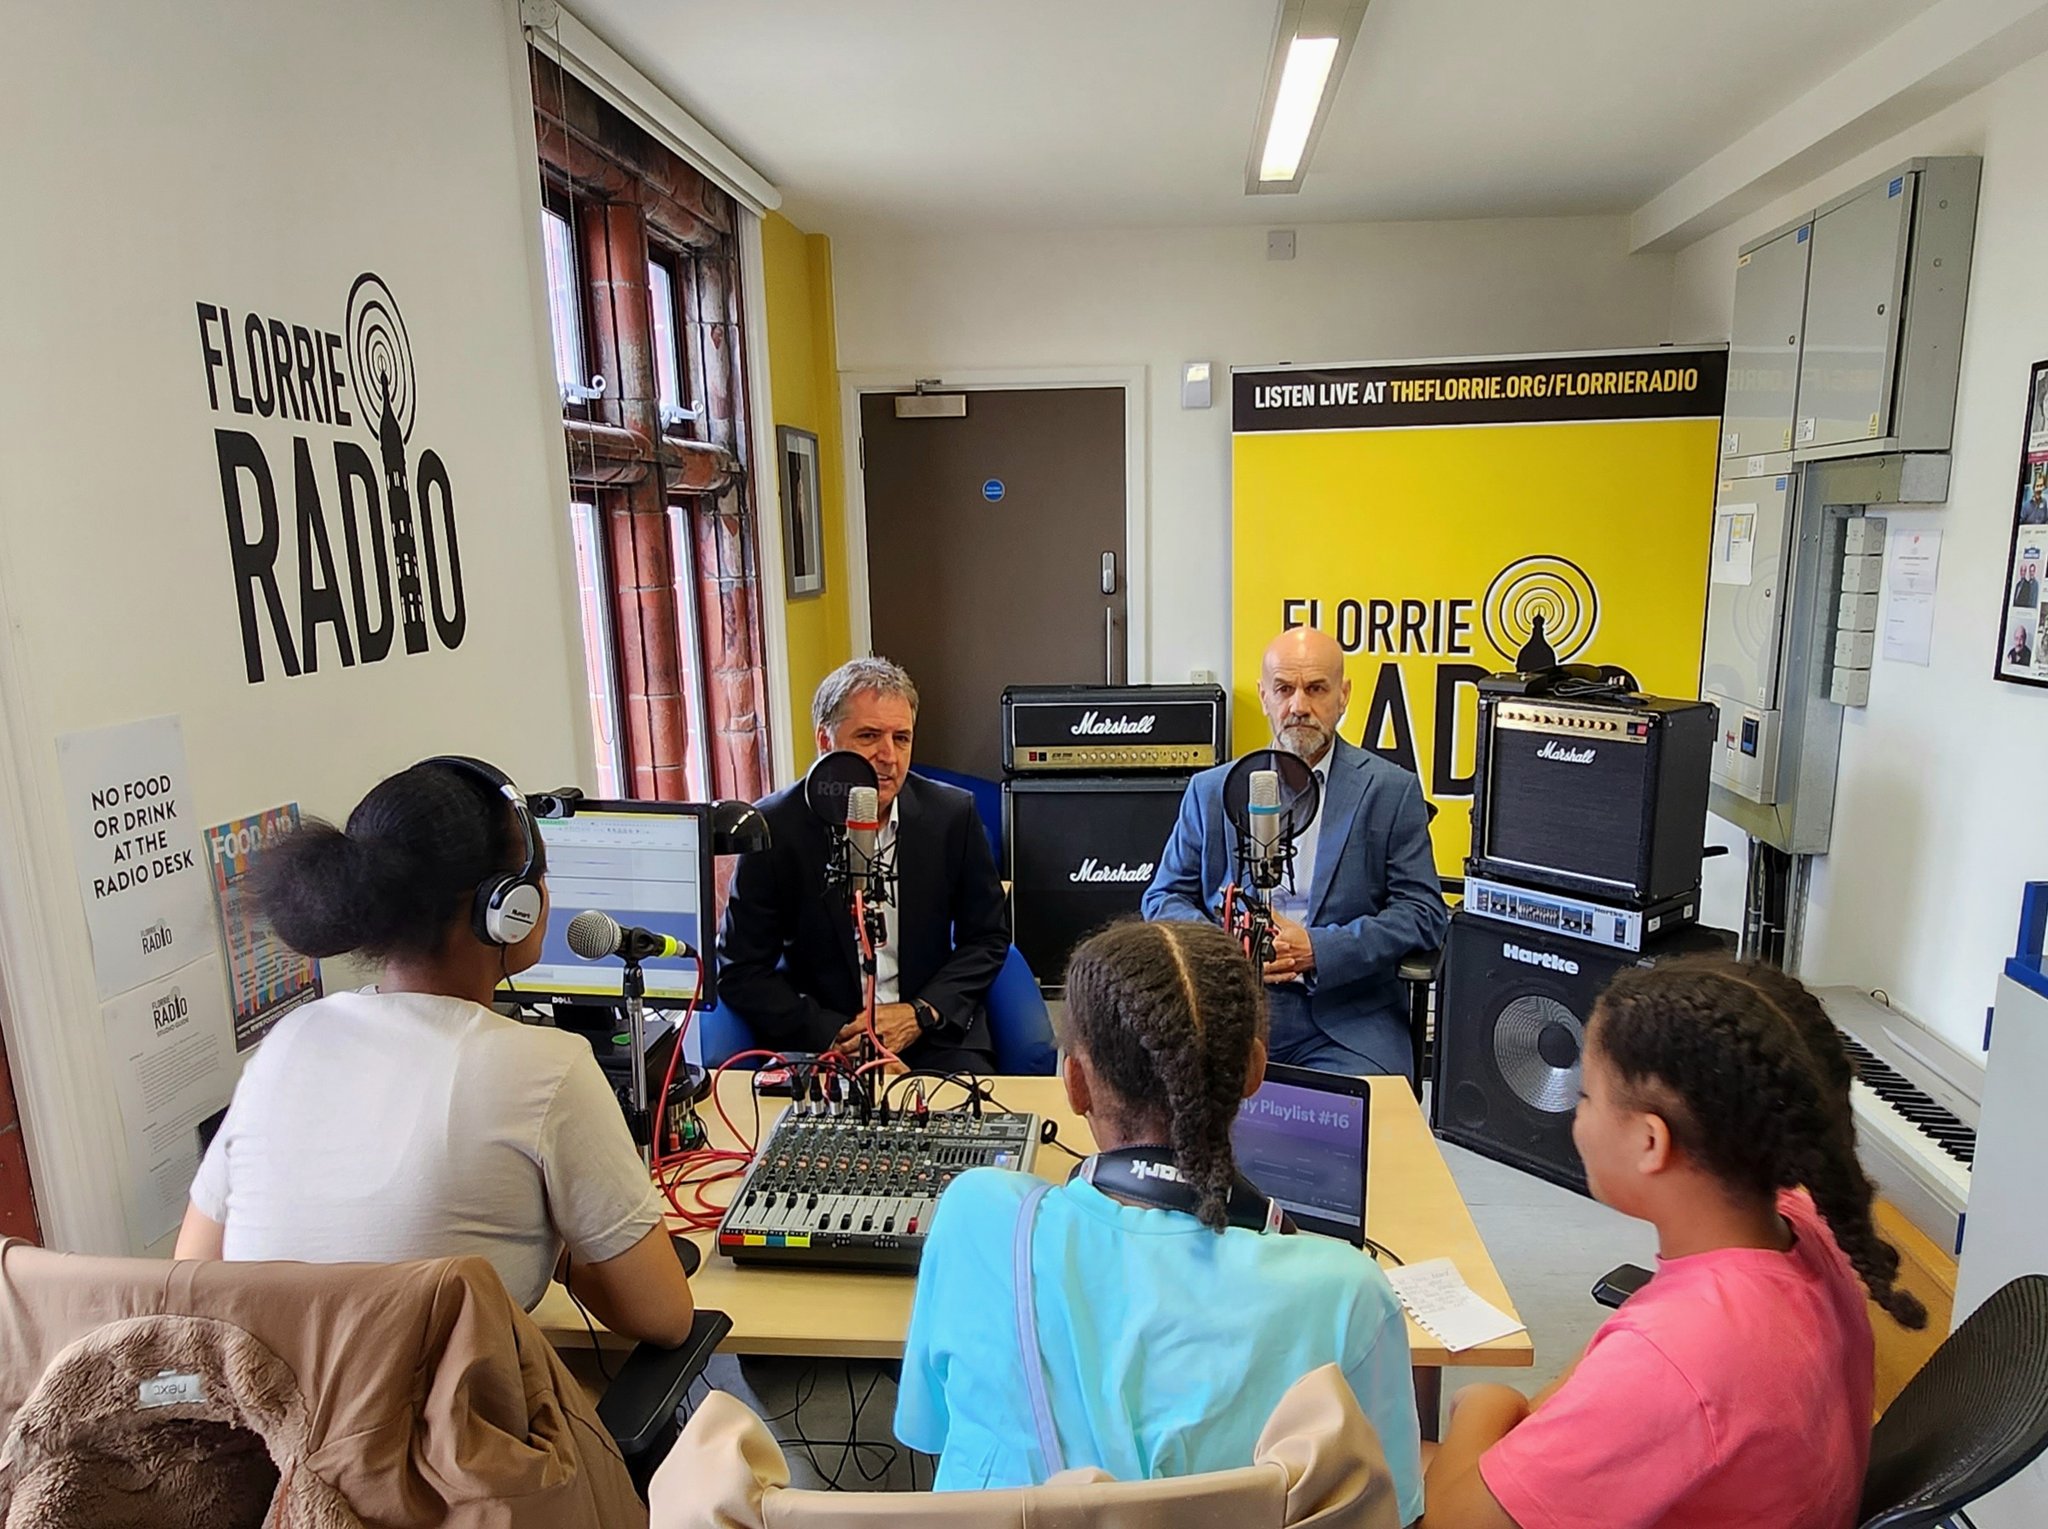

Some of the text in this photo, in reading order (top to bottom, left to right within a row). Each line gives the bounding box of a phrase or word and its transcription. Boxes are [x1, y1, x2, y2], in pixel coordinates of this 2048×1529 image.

[196, 301, 352, 427] FLORRIE
[1255, 368, 1698, 408] LISTEN LIVE AT THEFLORRIE.ORG/FLORRIERADIO
[214, 428, 466, 684] RADIO
[1071, 711, 1156, 735] Marshall
[1536, 741, 1596, 764] Marshall
[91, 775, 171, 811] NO FOOD
[94, 800, 177, 839] OR DRINK
[113, 830, 168, 865] AT THE
[211, 825, 262, 864] FOOD
[93, 865, 149, 900] RADIO
[152, 848, 194, 879] DESK
[1069, 858, 1154, 882] Marshall
[142, 926, 173, 955] RADIO
[1503, 943, 1579, 975] Hartke
[153, 994, 188, 1030] RADIO
[1260, 1099, 1316, 1123] Playlist
[1318, 1111, 1350, 1129] #16
[153, 1383, 187, 1396] next
